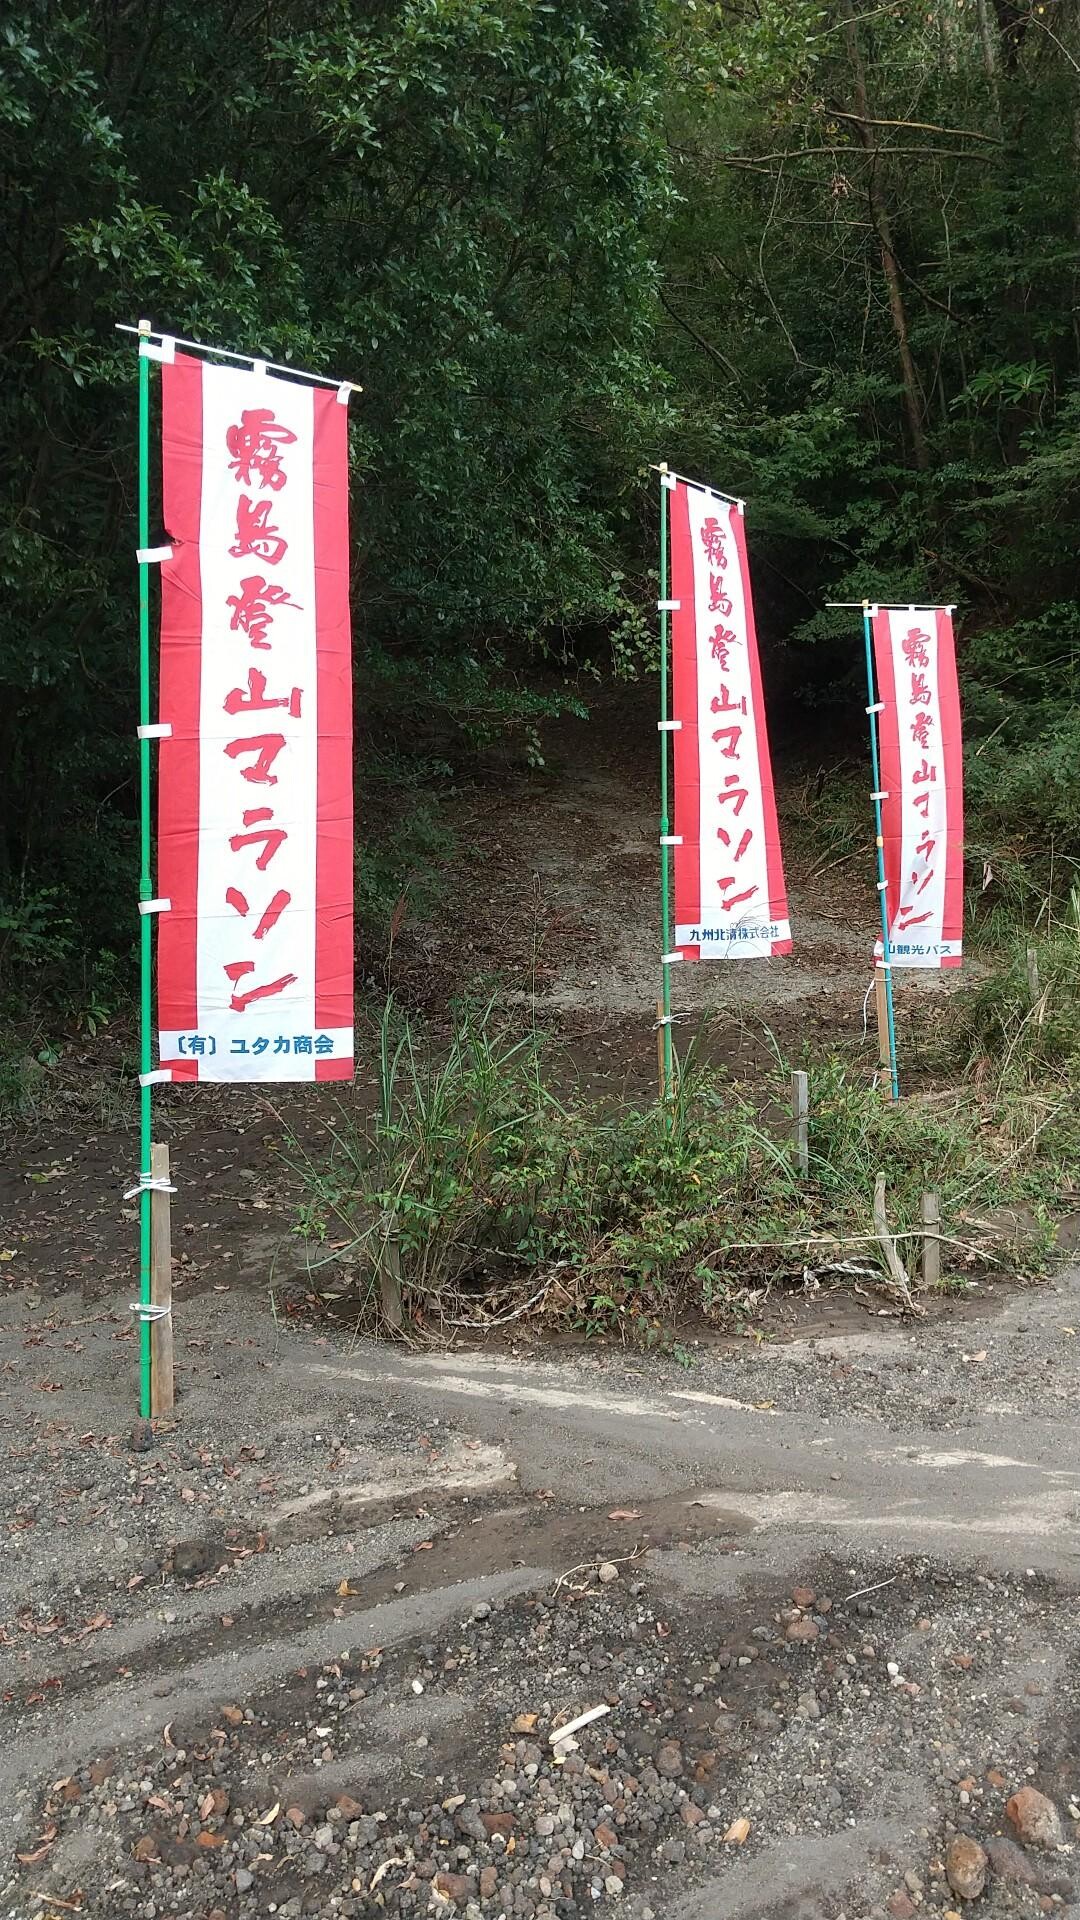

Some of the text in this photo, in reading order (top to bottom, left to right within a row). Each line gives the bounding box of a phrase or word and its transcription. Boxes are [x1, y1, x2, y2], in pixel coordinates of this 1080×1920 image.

[224, 409, 303, 1012] 霧島登山マラソン
[700, 517, 759, 911] 霧島登山マラソン
